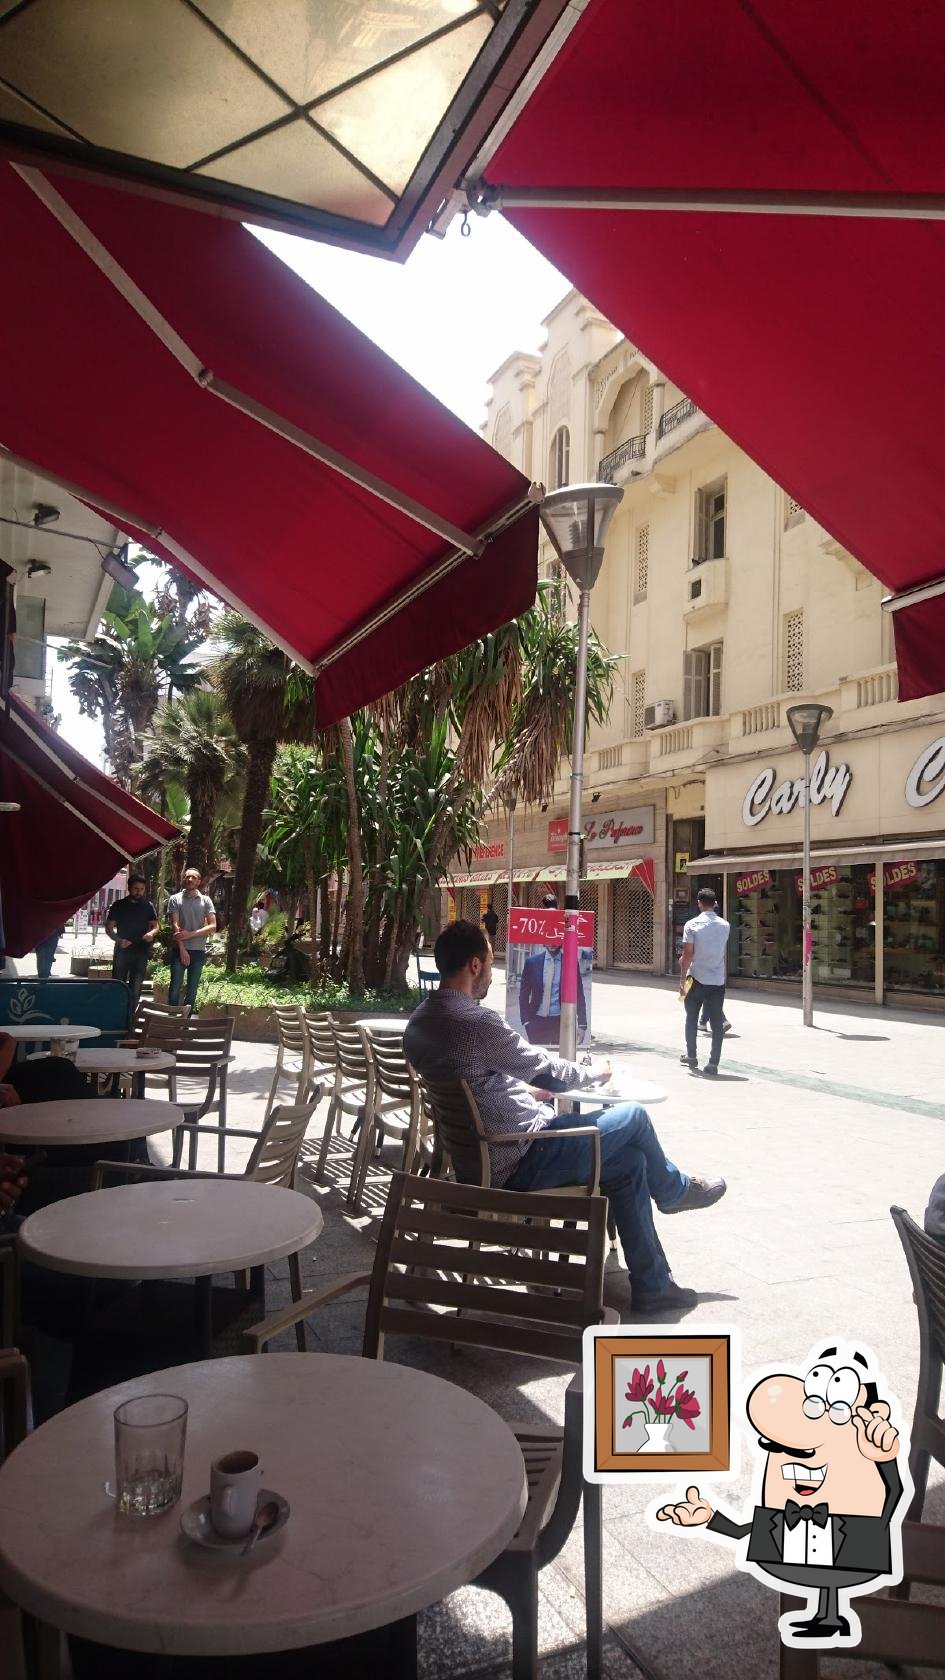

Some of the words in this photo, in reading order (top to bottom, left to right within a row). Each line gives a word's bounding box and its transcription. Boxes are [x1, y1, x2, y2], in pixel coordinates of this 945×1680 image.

[742, 751, 852, 826] Carly
[736, 870, 770, 893] SOLDES
[797, 866, 837, 892] SLDES
[870, 863, 917, 890] SLDES
[512, 918, 546, 936] -70%
